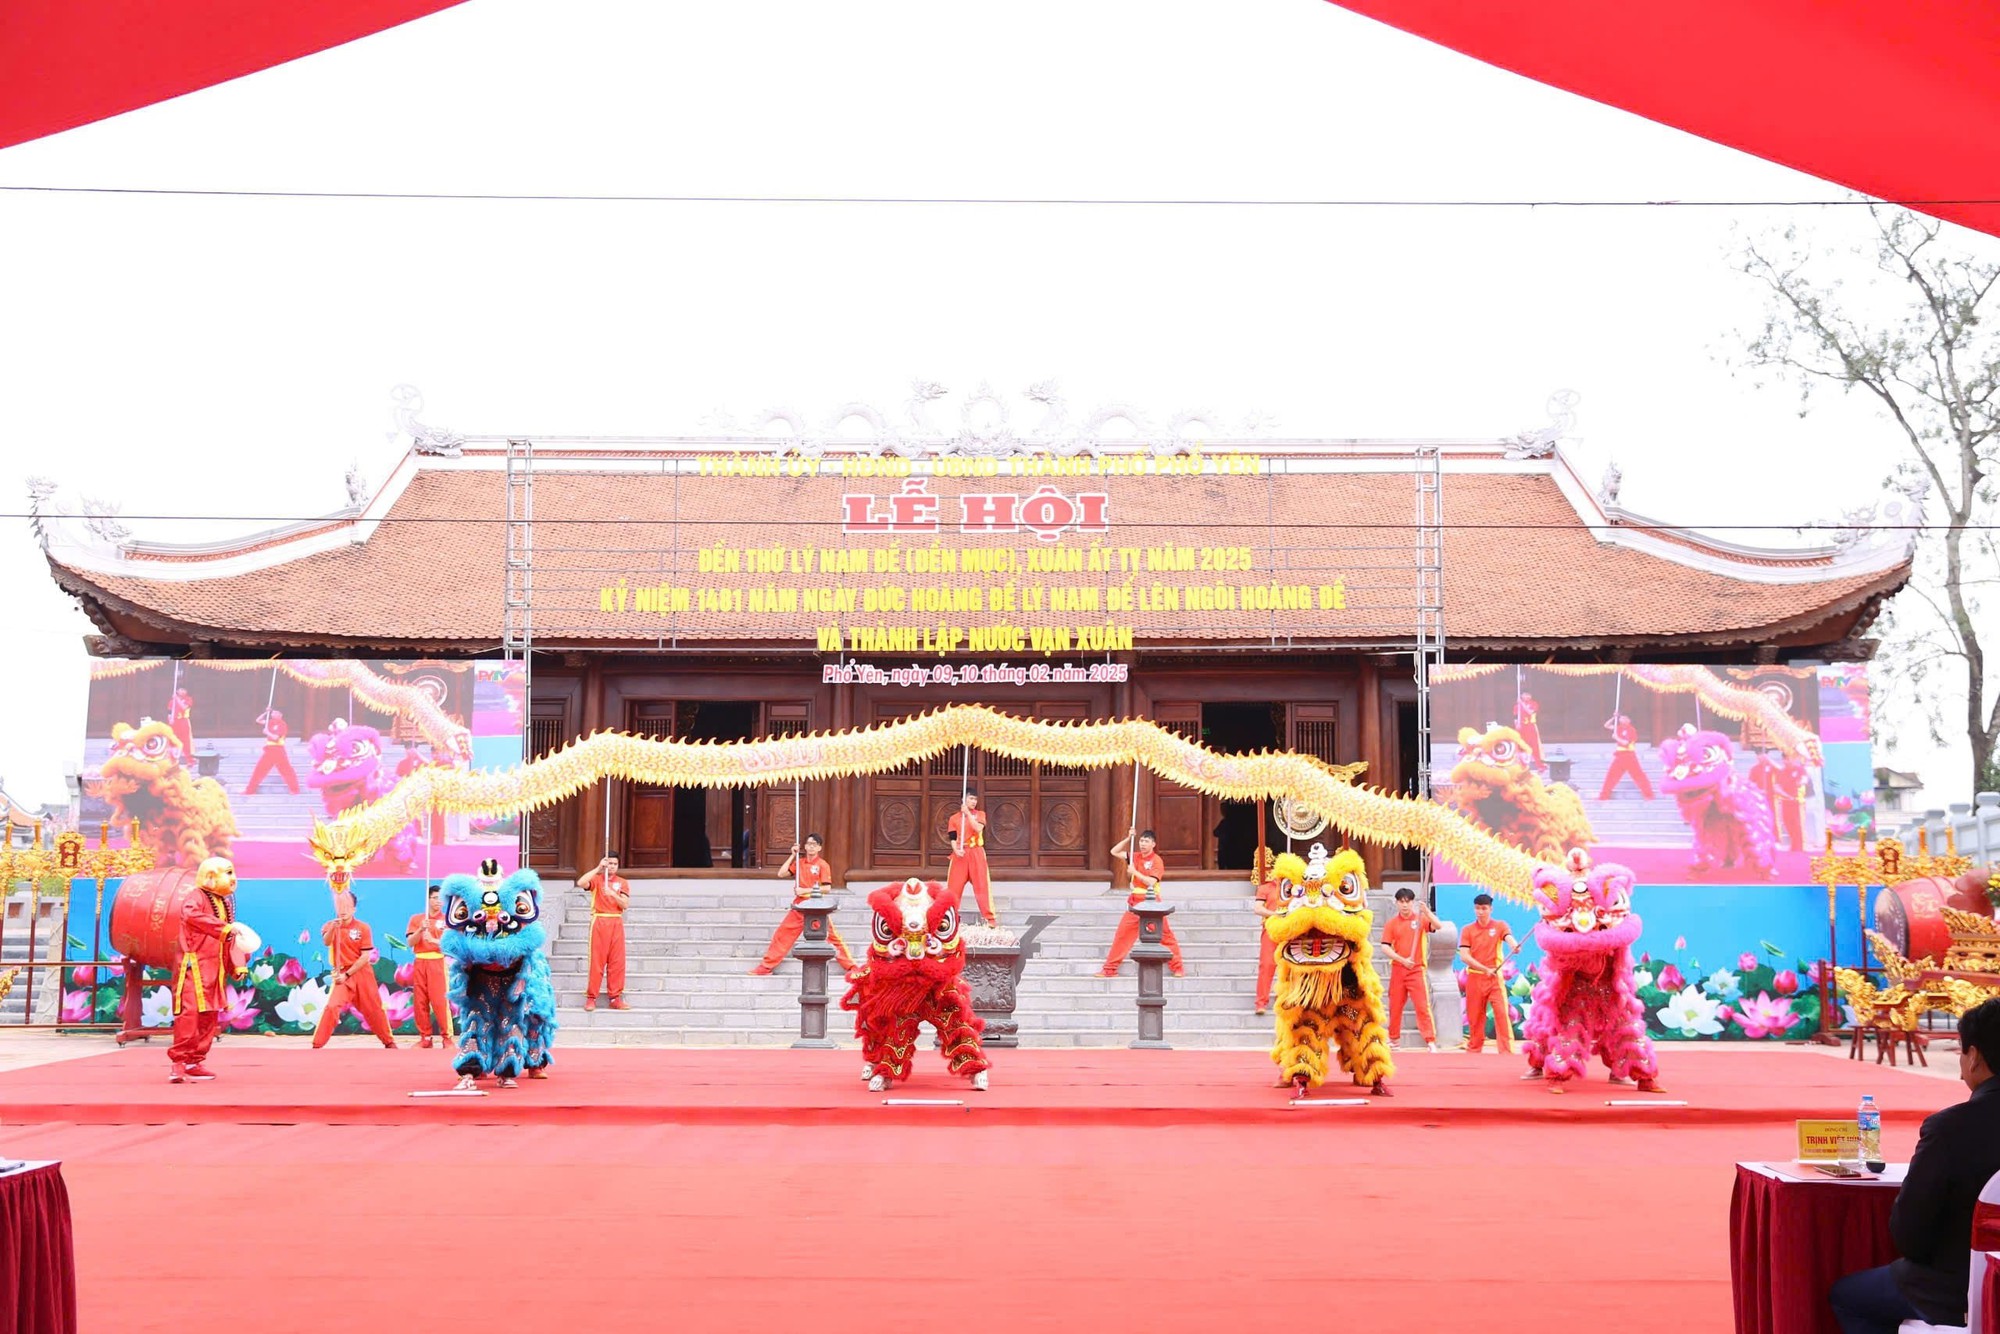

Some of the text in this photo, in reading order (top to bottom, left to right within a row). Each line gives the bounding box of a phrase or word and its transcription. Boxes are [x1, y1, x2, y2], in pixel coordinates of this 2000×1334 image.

[696, 450, 781, 477] THÀNH
[842, 455, 912, 477] HĐND
[932, 455, 998, 477] UBND
[1008, 450, 1092, 476] THÀNH
[1211, 449, 1260, 475] YÊN
[843, 476, 1108, 541] LỄ HỘI
[746, 541, 786, 573] THỜ
[791, 542, 815, 573] LÝ
[820, 548, 868, 573] NAM
[874, 538, 900, 573] ĐẾ
[961, 547, 1022, 579] MỤC),
[1027, 542, 1082, 572] XUÂN
[1088, 538, 1112, 572] ẤT
[1147, 541, 1195, 571] NĂM
[1200, 546, 1252, 571] 2025
[635, 581, 690, 617] NIỆM
[697, 588, 742, 612] 1481
[749, 583, 797, 612] NĂM
[804, 583, 857, 612] NGÀY
[864, 581, 905, 612] ĐỨC
[912, 582, 982, 612] HOÀNG
[989, 577, 1017, 612] ĐẾ
[1022, 581, 1043, 612] LÝ
[1051, 587, 1099, 611] NAM
[1106, 574, 1134, 611] ĐẾ
[1139, 581, 1179, 611] LÊN
[1185, 580, 1236, 610] NGÔI
[1241, 579, 1312, 610] HOÀNG
[1319, 574, 1346, 609] ĐẾ
[817, 619, 1132, 657] VÀ THÀNH LẬP NƯỚC VẠN XUÂN
[823, 658, 1128, 687] Phổ Yên, ngày 09, 10 tháng 02 năm 2025
[1806, 1136, 1828, 1146] TRỊNH
